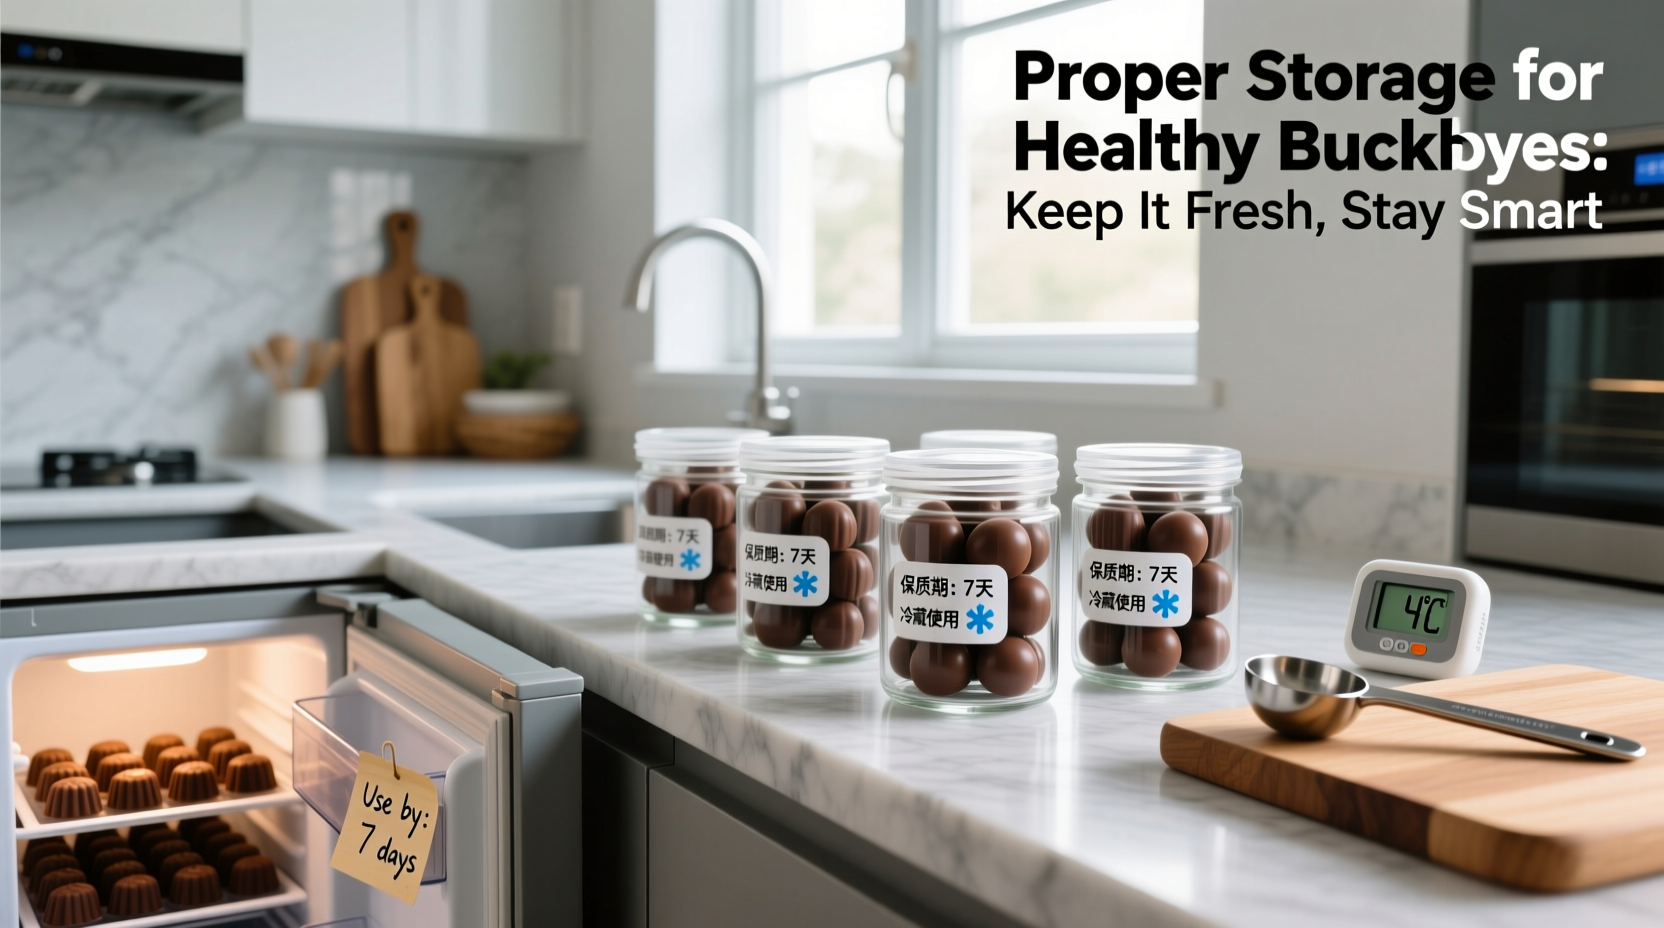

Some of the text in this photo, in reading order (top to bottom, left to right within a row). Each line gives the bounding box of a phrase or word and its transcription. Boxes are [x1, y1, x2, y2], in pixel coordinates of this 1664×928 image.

[363, 781, 430, 839] Use by:
[359, 821, 418, 881] 7 days
